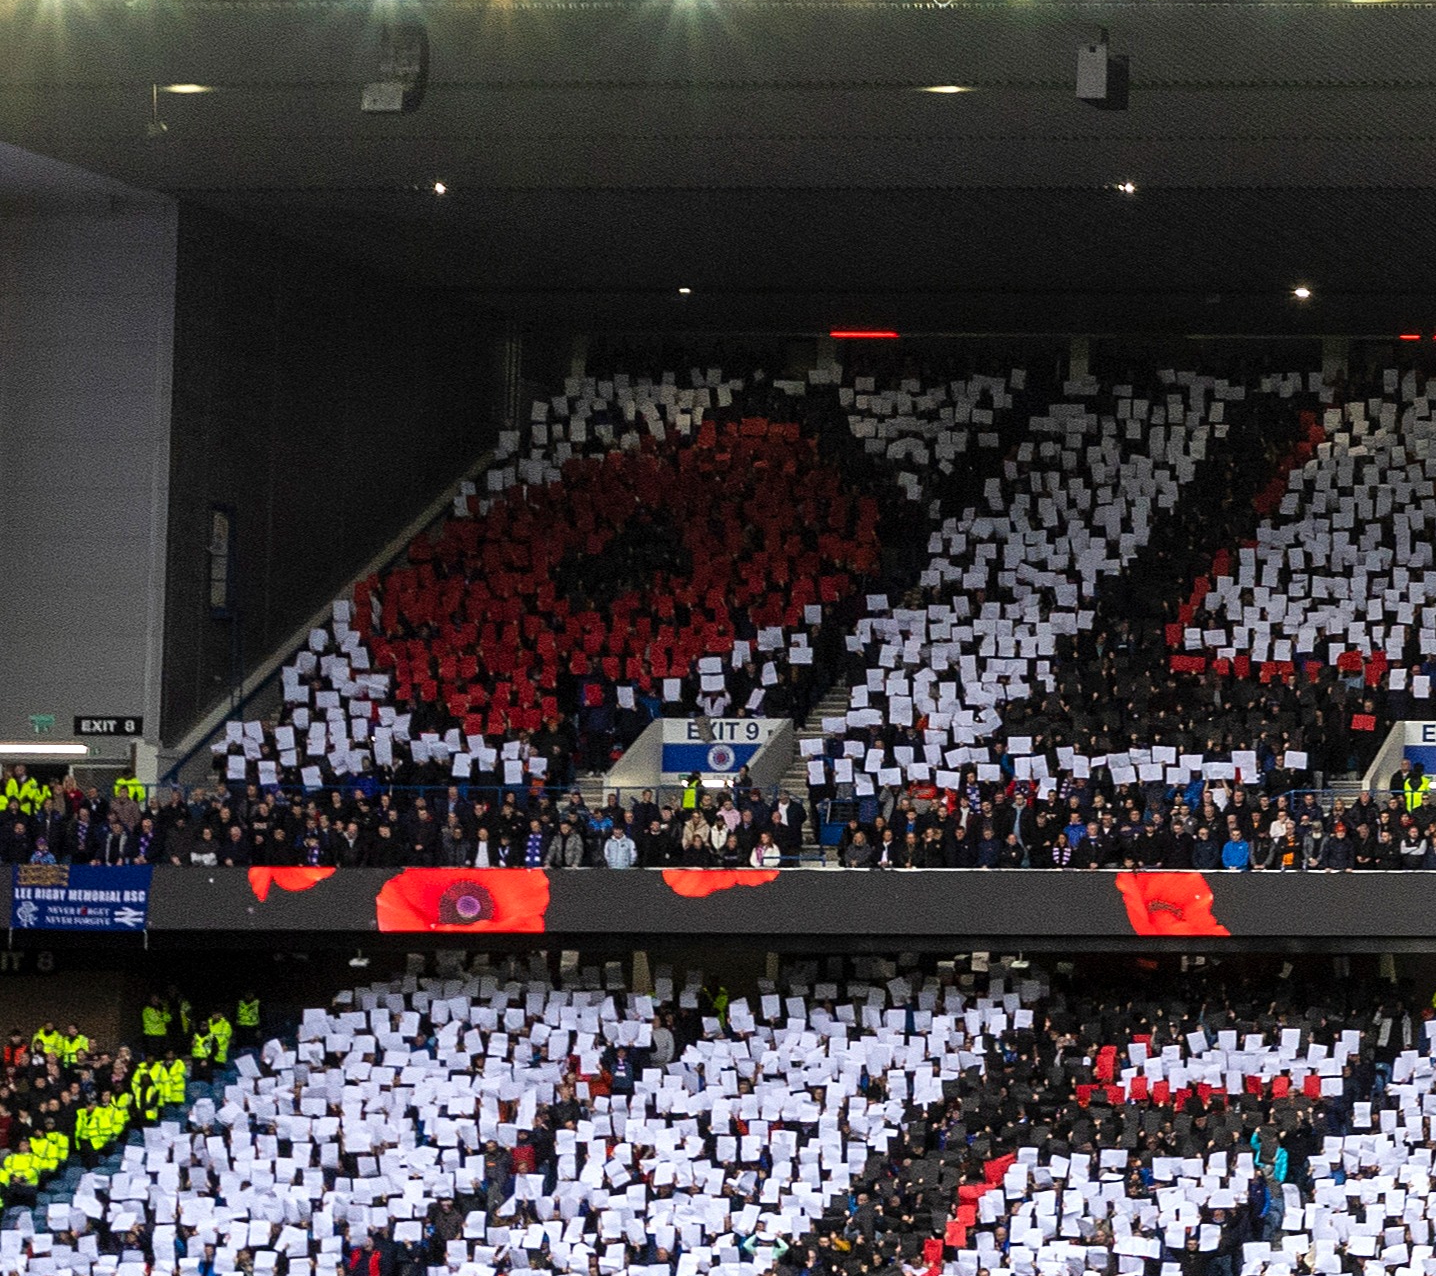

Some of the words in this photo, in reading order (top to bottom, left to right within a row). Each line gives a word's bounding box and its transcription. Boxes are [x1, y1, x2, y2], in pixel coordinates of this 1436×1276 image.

[81, 719, 117, 733] EXIT
[746, 721, 760, 741] 9
[14, 887, 32, 900] LEE
[34, 888, 67, 901] RIGBY
[68, 889, 121, 903] MEMORIAL
[77, 906, 111, 916] FRGET
